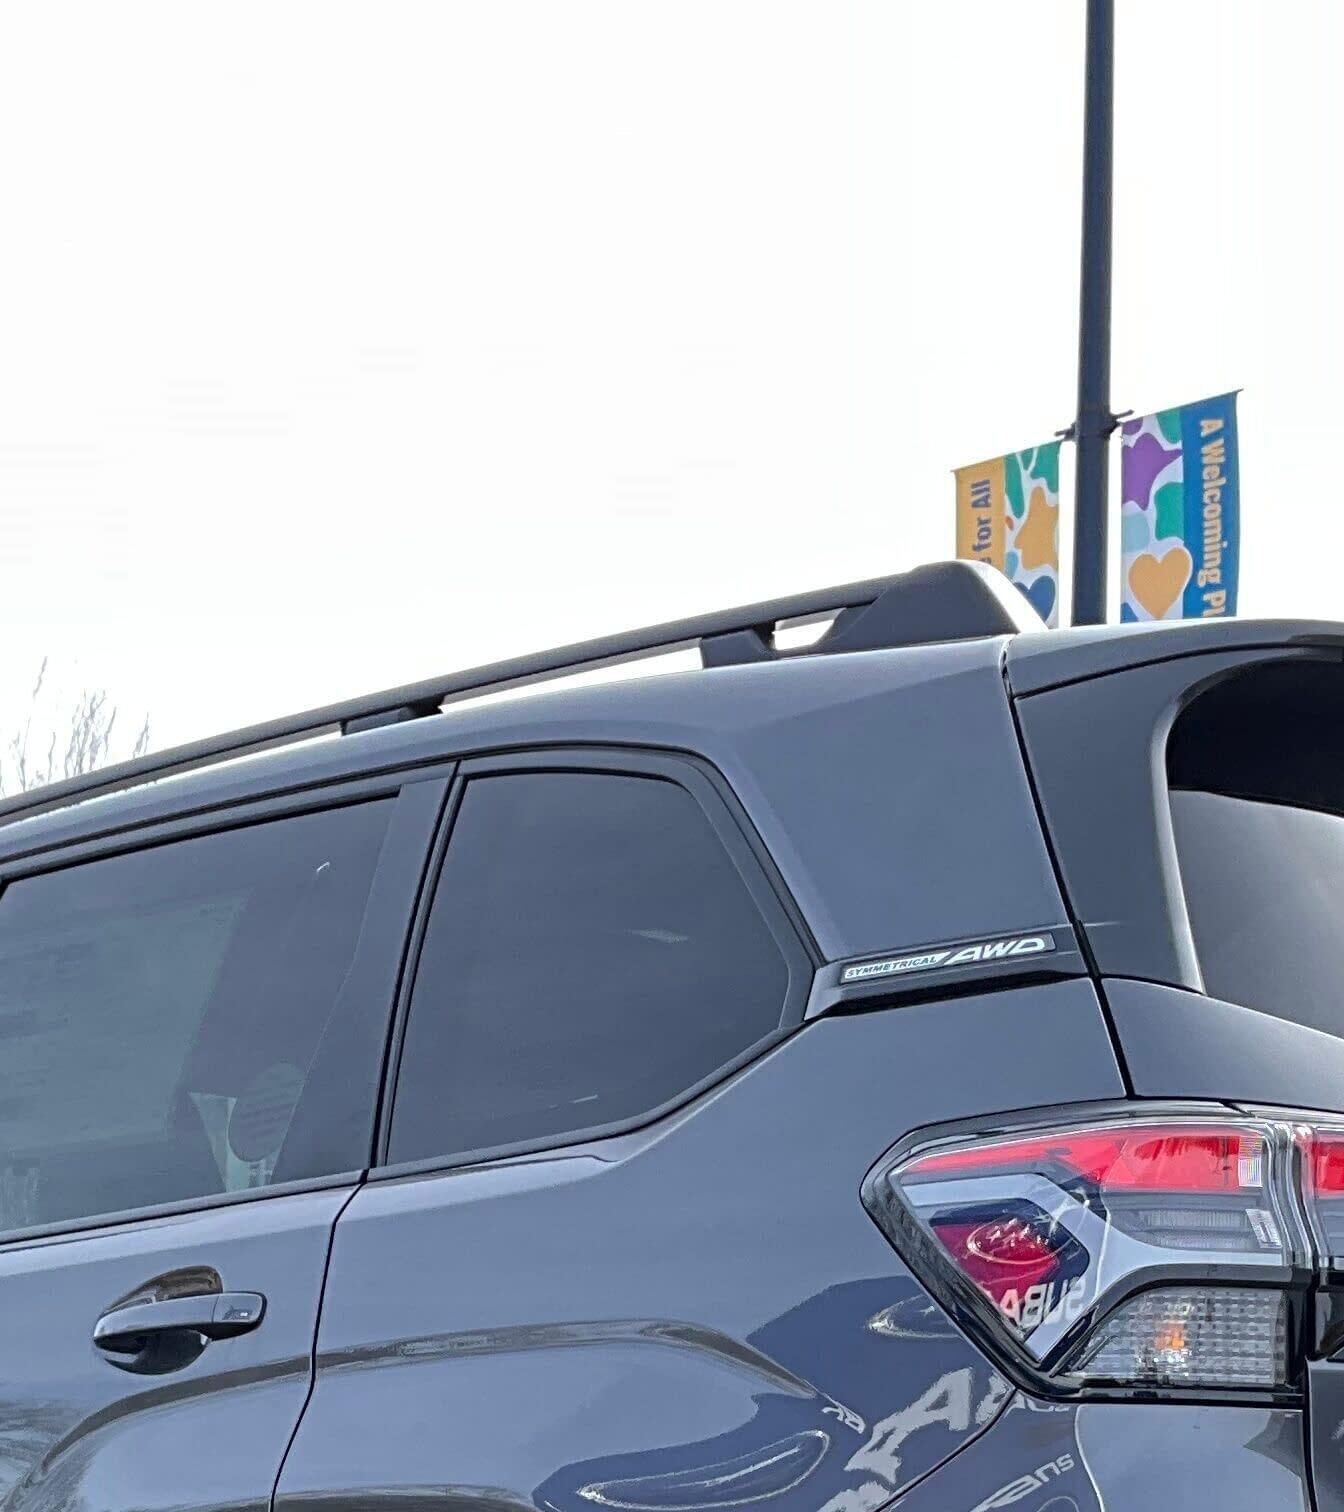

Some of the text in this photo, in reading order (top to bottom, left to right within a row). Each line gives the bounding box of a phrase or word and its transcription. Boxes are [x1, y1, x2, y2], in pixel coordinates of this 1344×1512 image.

[1200, 418, 1224, 437] A
[971, 479, 992, 552] for All
[1197, 438, 1227, 588] Welcoming
[845, 938, 1046, 978] SYMMETRICAL AWD
